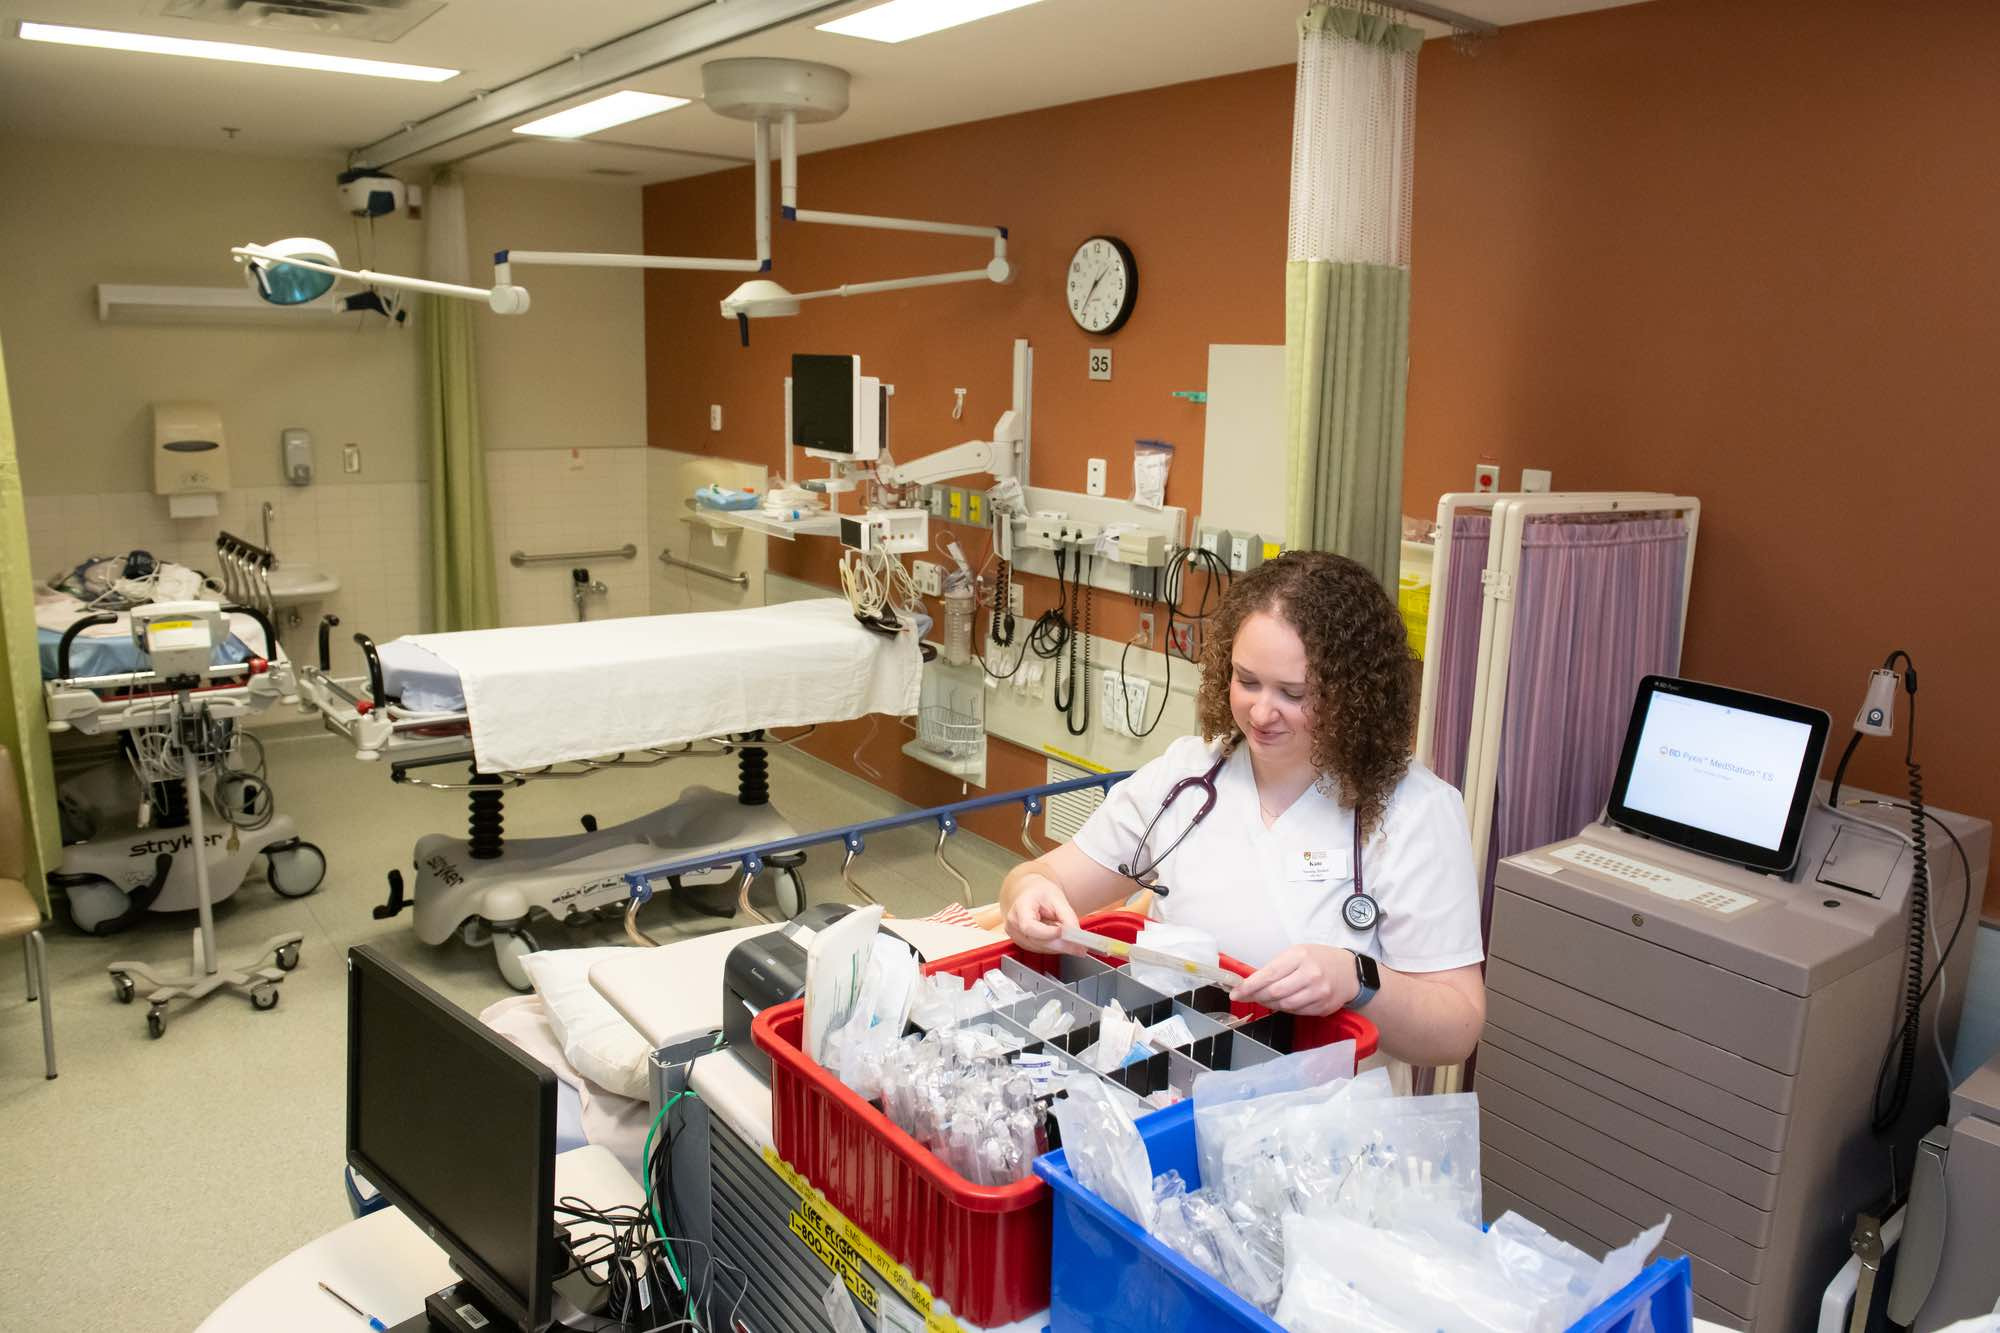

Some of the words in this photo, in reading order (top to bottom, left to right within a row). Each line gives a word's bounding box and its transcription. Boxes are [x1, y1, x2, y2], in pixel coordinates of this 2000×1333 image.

[1091, 355, 1109, 373] 35
[129, 833, 223, 857] stryker
[802, 1201, 823, 1231] LIFE
[824, 1224, 861, 1268] FLIGHT
